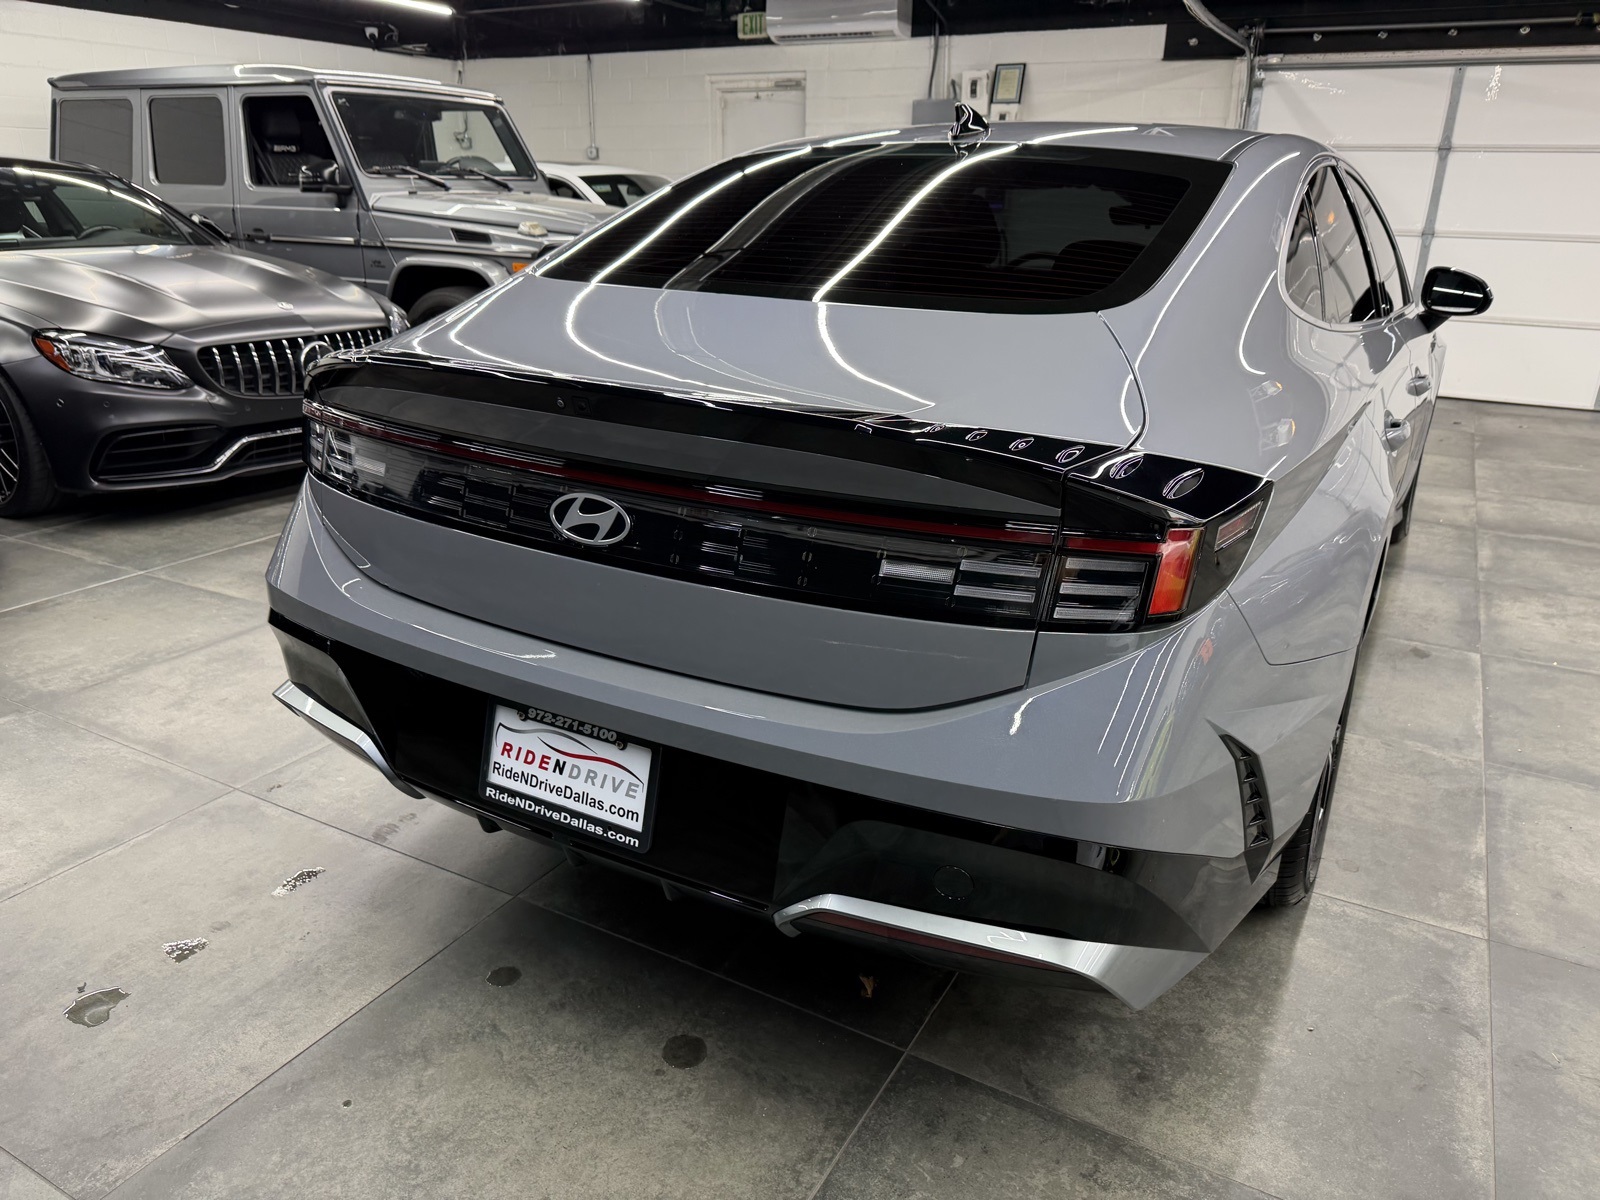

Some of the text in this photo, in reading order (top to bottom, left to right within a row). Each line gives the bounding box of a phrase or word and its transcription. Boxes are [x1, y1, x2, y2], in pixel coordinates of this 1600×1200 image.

[743, 14, 763, 35] EXIT
[528, 708, 617, 742] 972-271-5100
[493, 761, 639, 822] RideNDriveDallas.com
[486, 787, 639, 847] RideNDriveDallas.com
